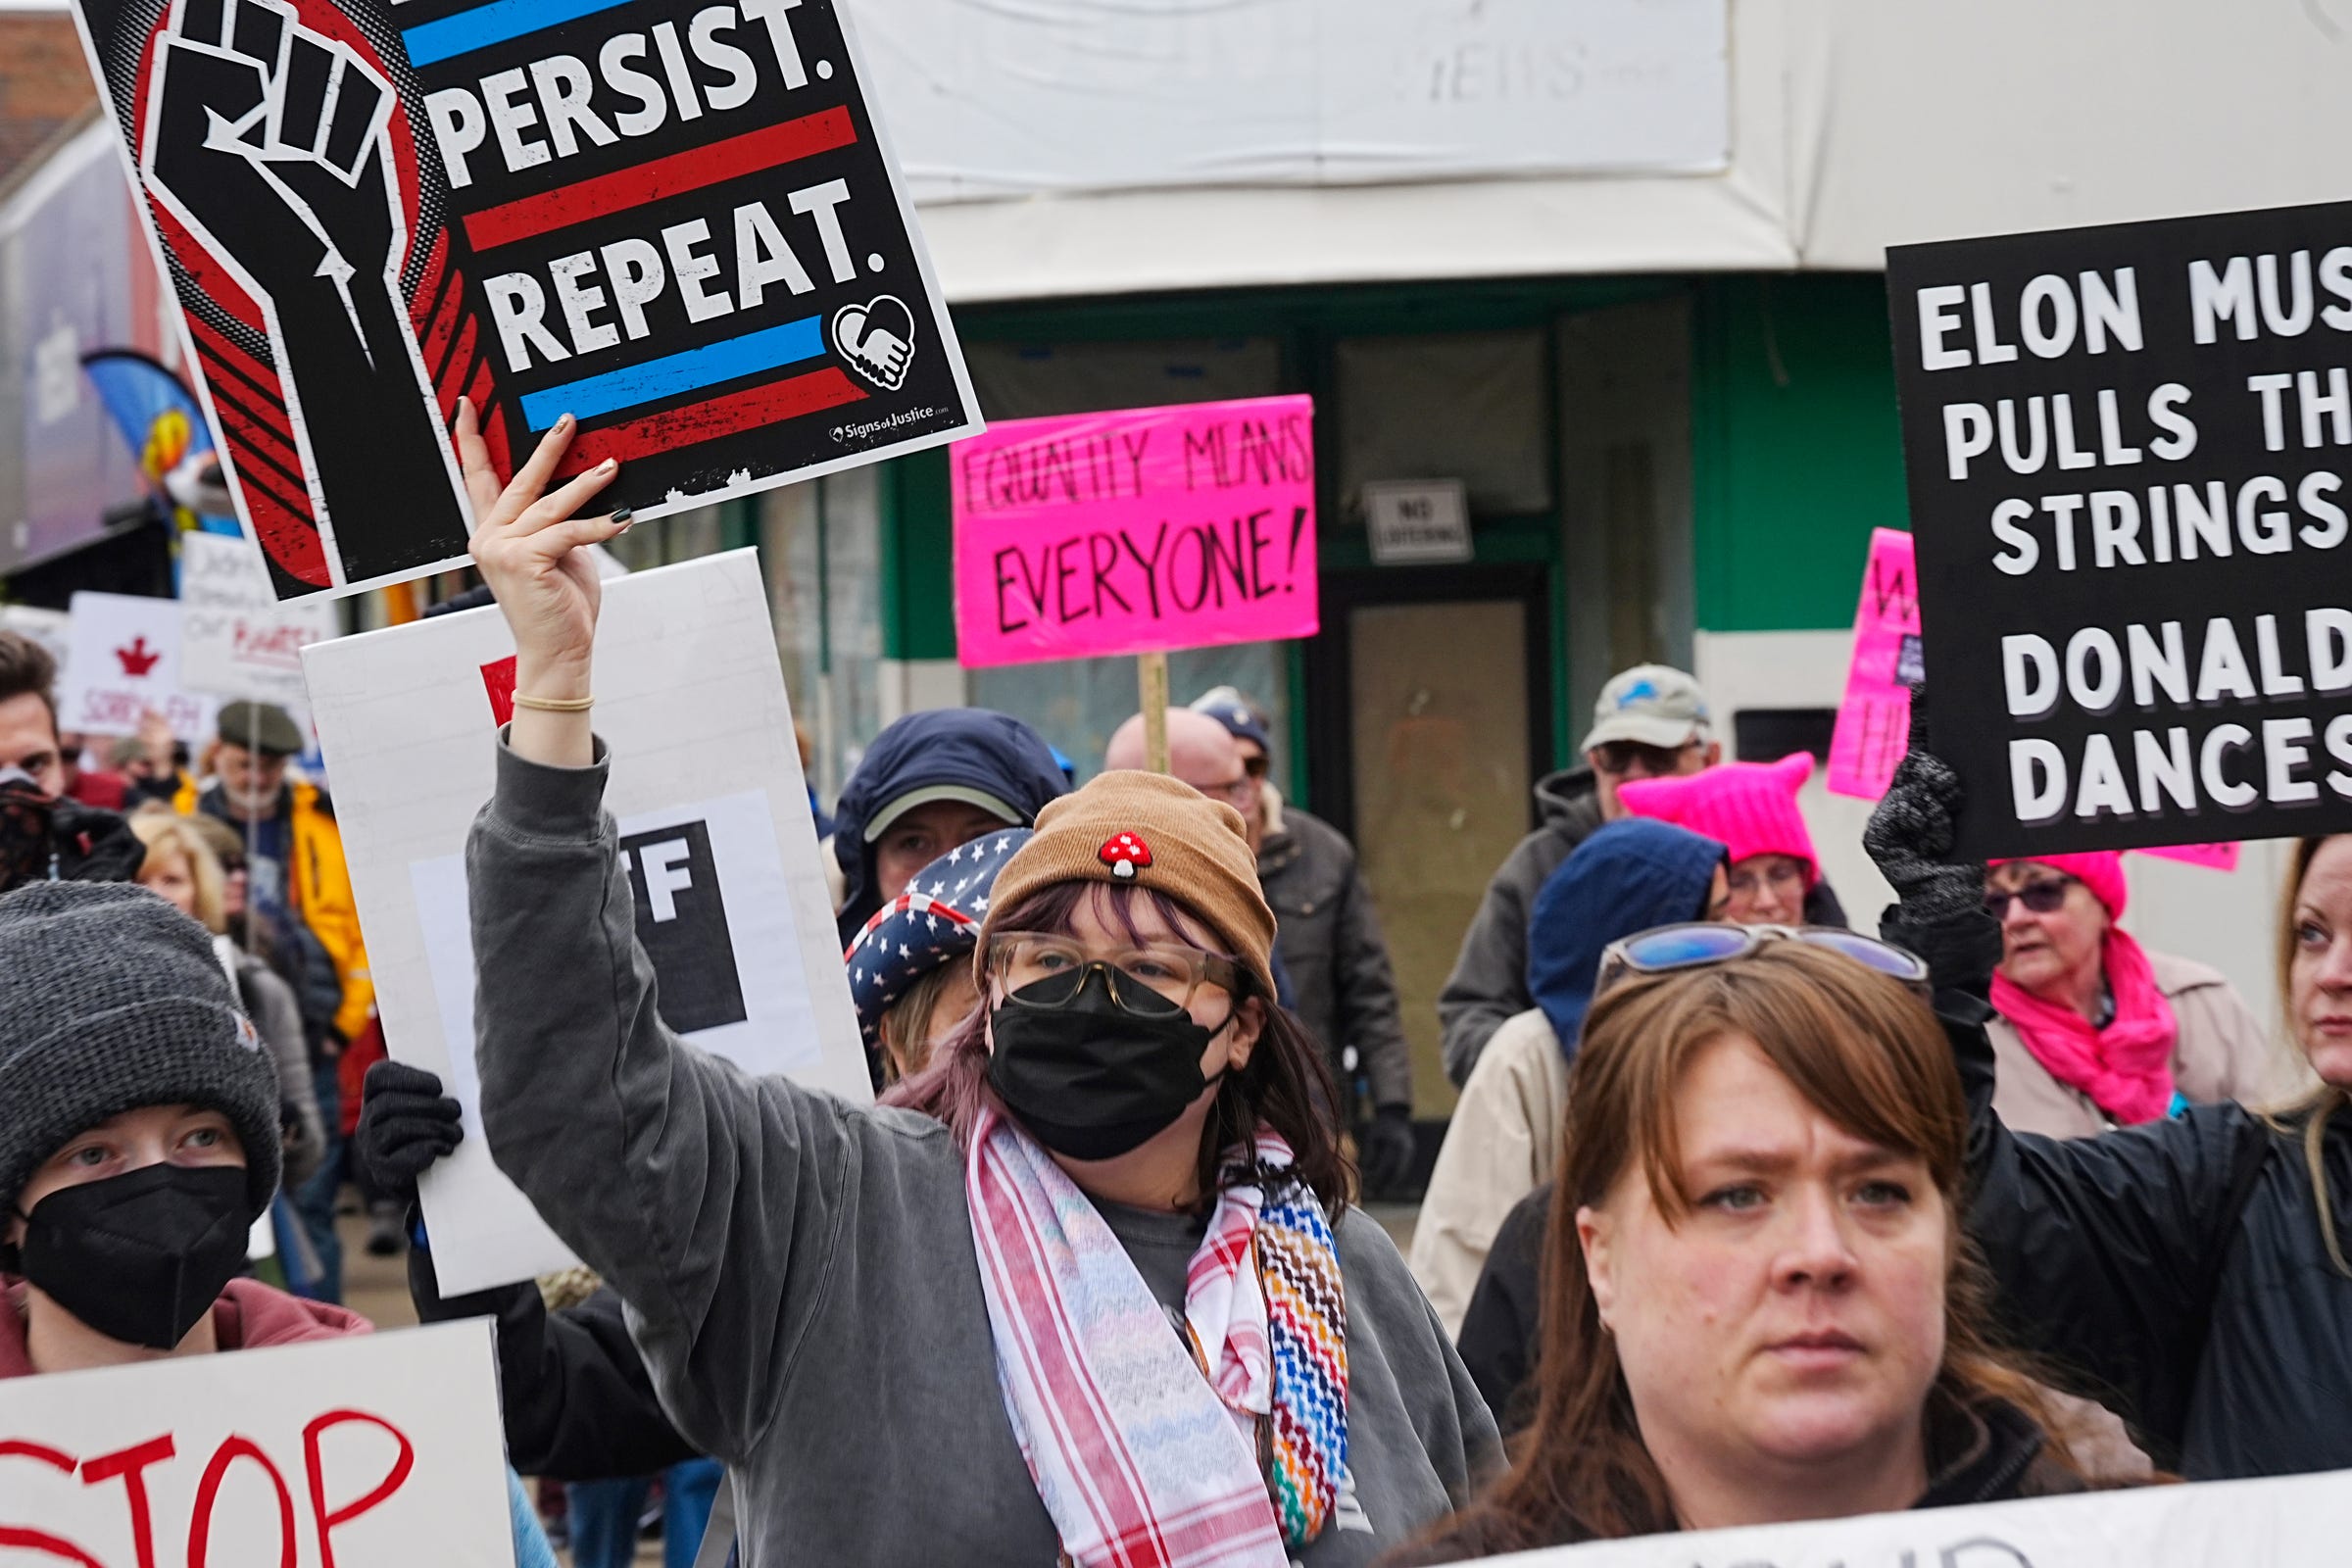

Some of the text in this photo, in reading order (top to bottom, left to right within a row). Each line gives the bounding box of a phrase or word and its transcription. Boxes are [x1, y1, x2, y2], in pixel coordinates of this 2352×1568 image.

[422, 0, 833, 189] PERSIST.
[482, 177, 884, 372] REPEAT.
[1917, 267, 2144, 371] ELON
[961, 413, 1312, 514] EQUALITY MEANS
[1942, 368, 2352, 480] PULLS TH
[994, 506, 1308, 634] EVERYONE!
[1990, 470, 2349, 575] STRINGS
[2001, 607, 2352, 717] DONALD
[2009, 713, 2352, 821] DANCES
